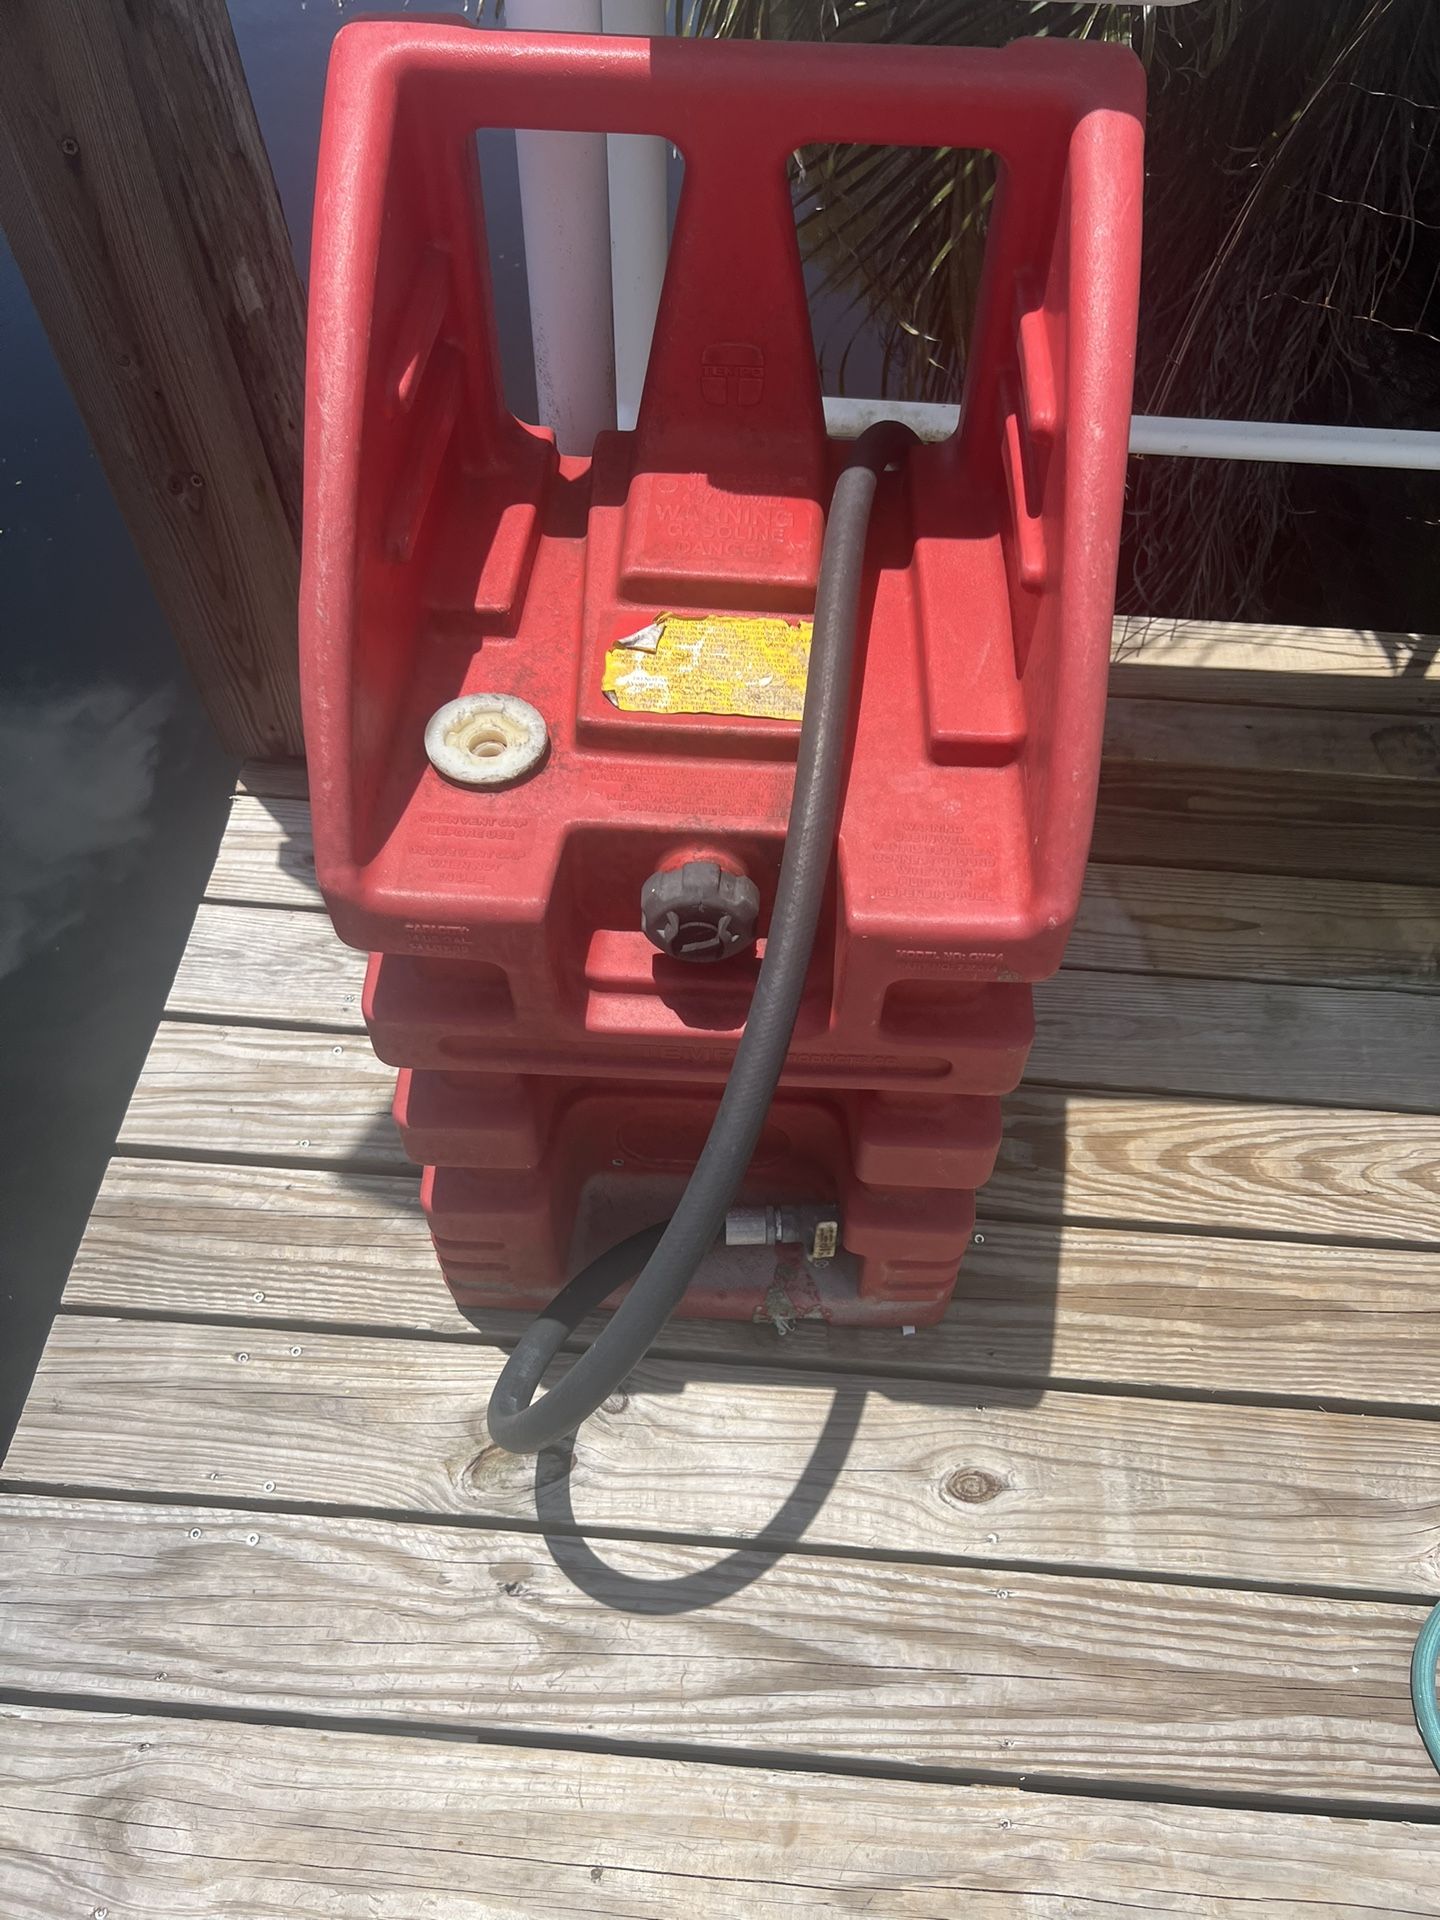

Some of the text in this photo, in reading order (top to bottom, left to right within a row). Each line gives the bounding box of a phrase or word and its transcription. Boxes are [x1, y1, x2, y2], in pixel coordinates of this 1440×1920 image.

[655, 503, 795, 528] WARNING
[667, 523, 785, 544] GASOLINE
[677, 541, 773, 559] DANGER
[420, 815, 460, 826] OPEN
[461, 816, 496, 827] VENT
[902, 822, 965, 835] WARNING
[486, 830, 516, 841] USE
